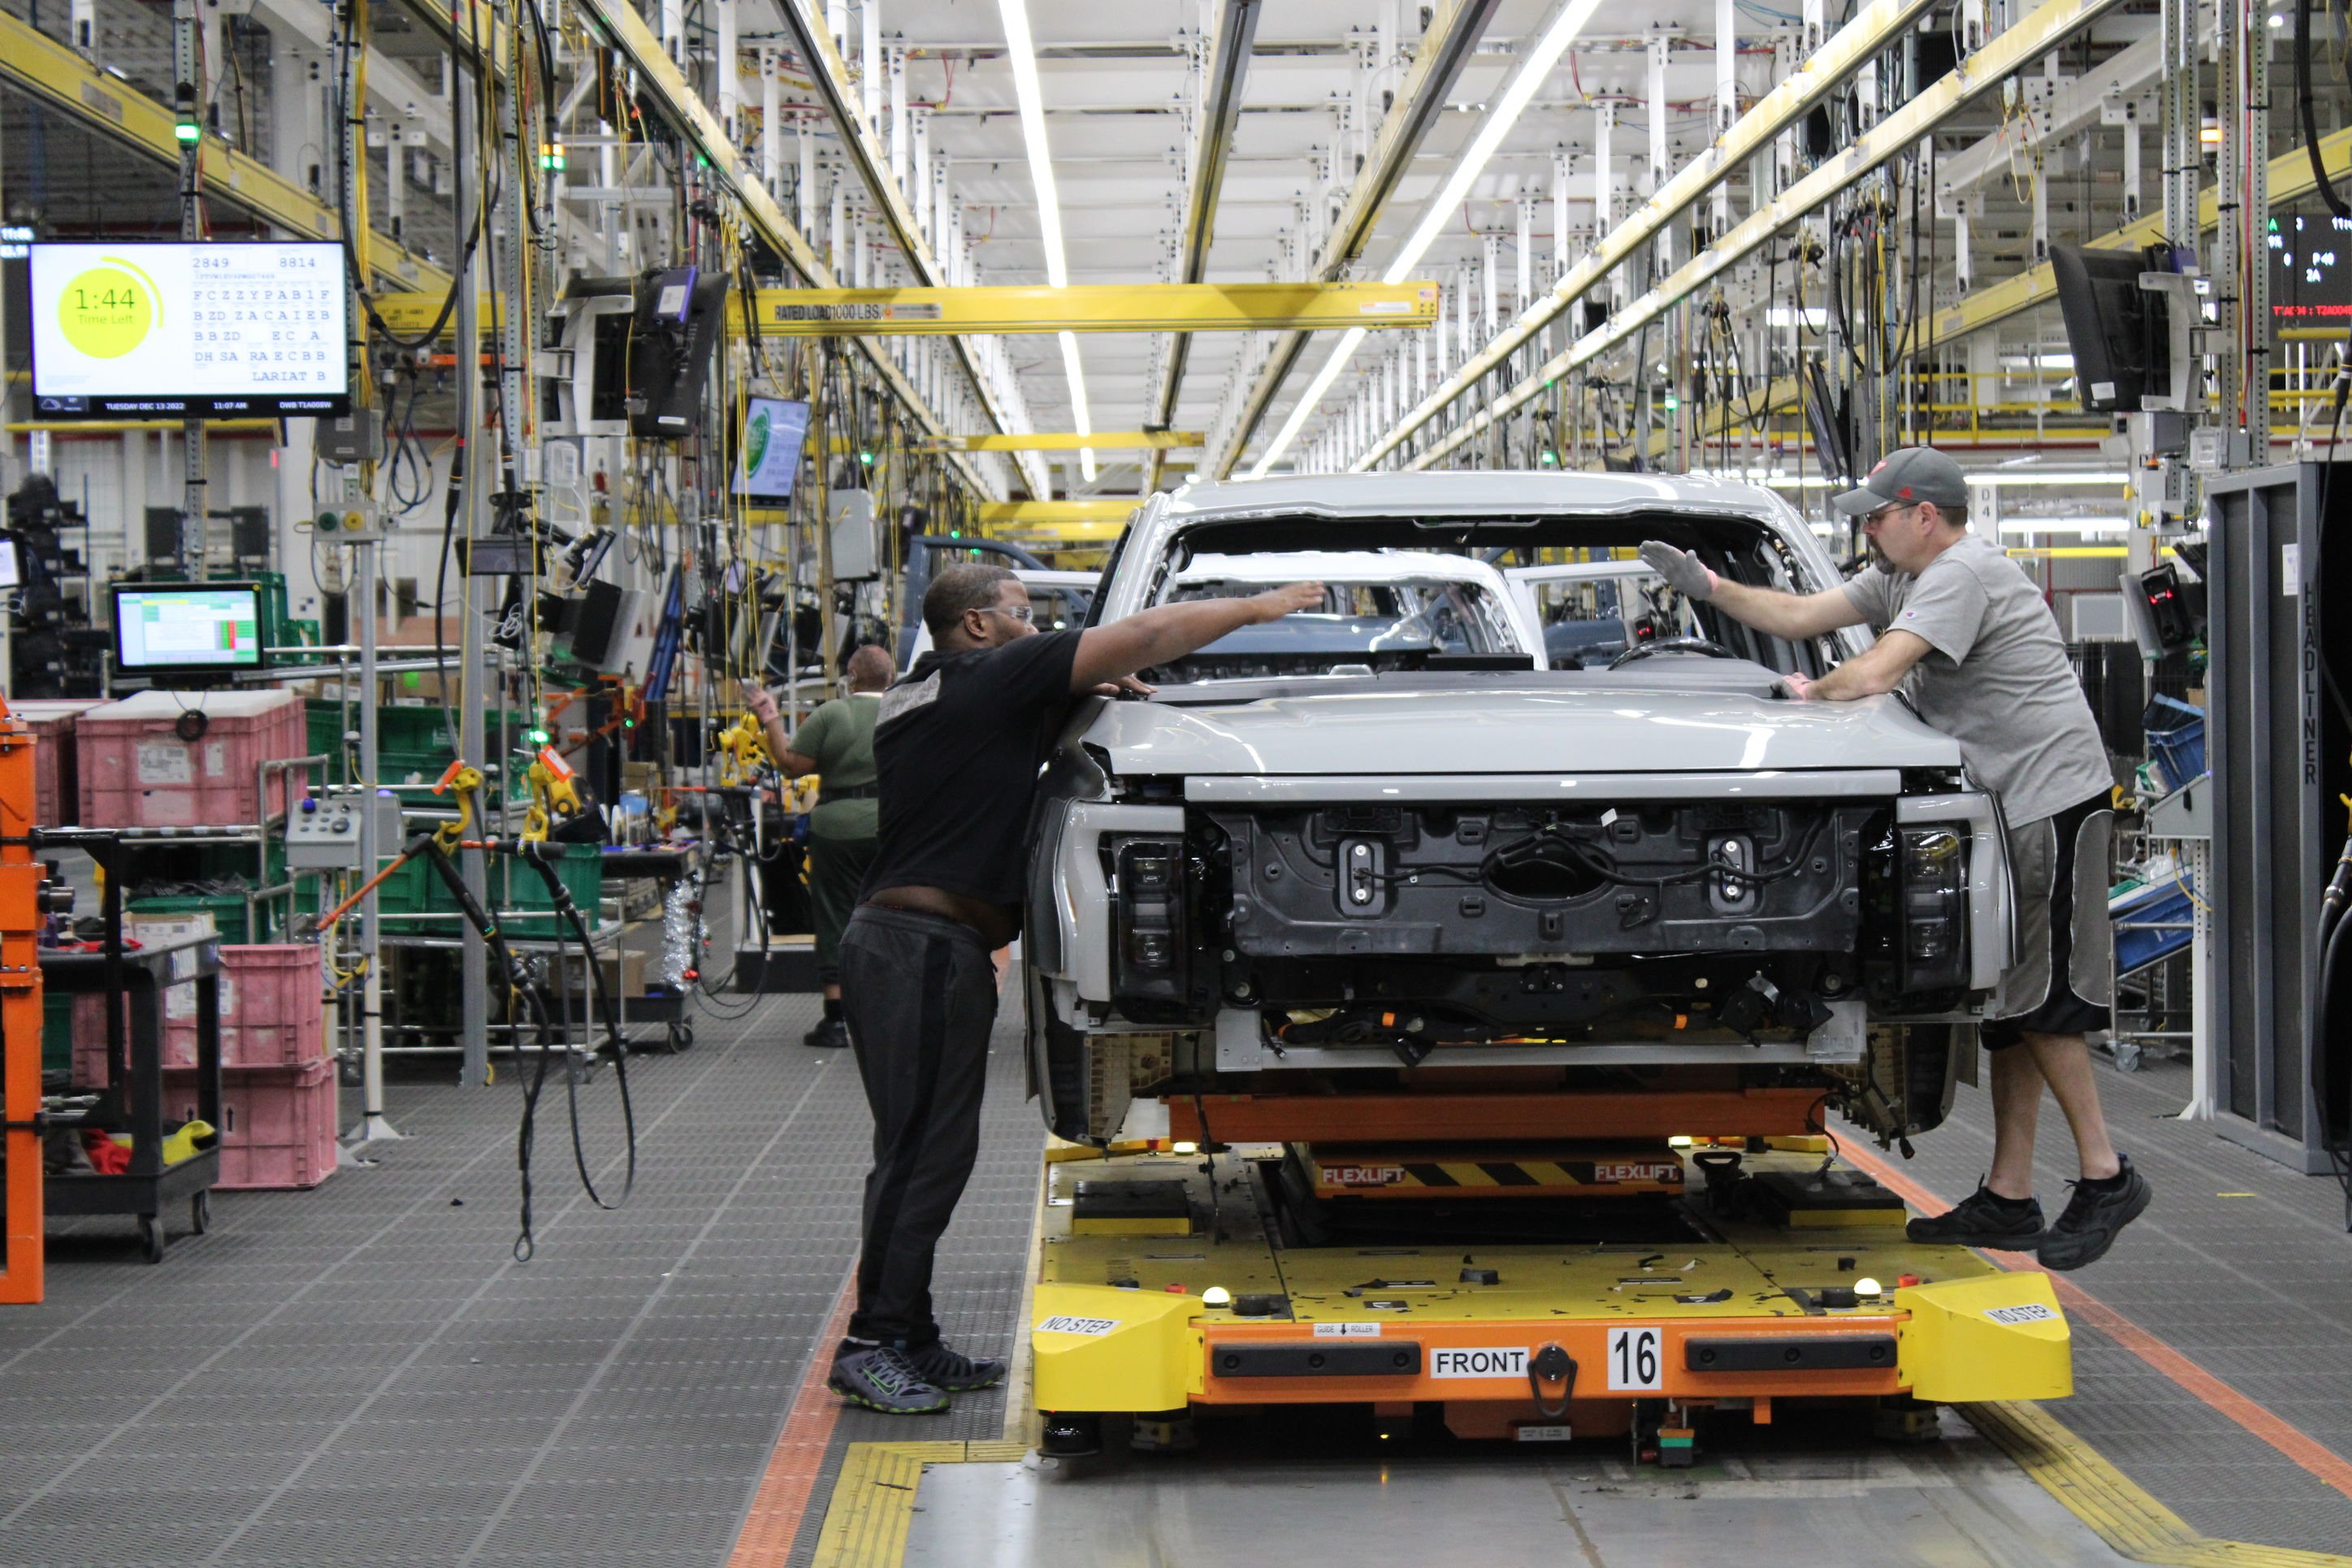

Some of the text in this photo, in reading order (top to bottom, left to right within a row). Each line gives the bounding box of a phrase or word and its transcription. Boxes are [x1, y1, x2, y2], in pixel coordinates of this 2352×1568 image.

[193, 258, 229, 268] 2849
[279, 258, 315, 268] 8814
[75, 288, 135, 310] 1:44
[78, 314, 133, 325] Time Left
[775, 305, 805, 320] RATED
[830, 304, 855, 319] 1000
[253, 371, 325, 381] LARIAT B
[106, 402, 138, 410] TUESDAY
[139, 402, 154, 410] DEC
[2304, 582, 2316, 785] HEADLINER
[1322, 1167, 1405, 1183] FLEXLIFT
[1595, 1164, 1677, 1181] FLEXLIFT
[1987, 1305, 2050, 1323] NO STEP
[1041, 1317, 1113, 1333] NO STEP
[1317, 1325, 1373, 1333] GUIDE ROLLER
[1436, 1352, 1524, 1373] FRONT
[1614, 1331, 1656, 1384] 16
